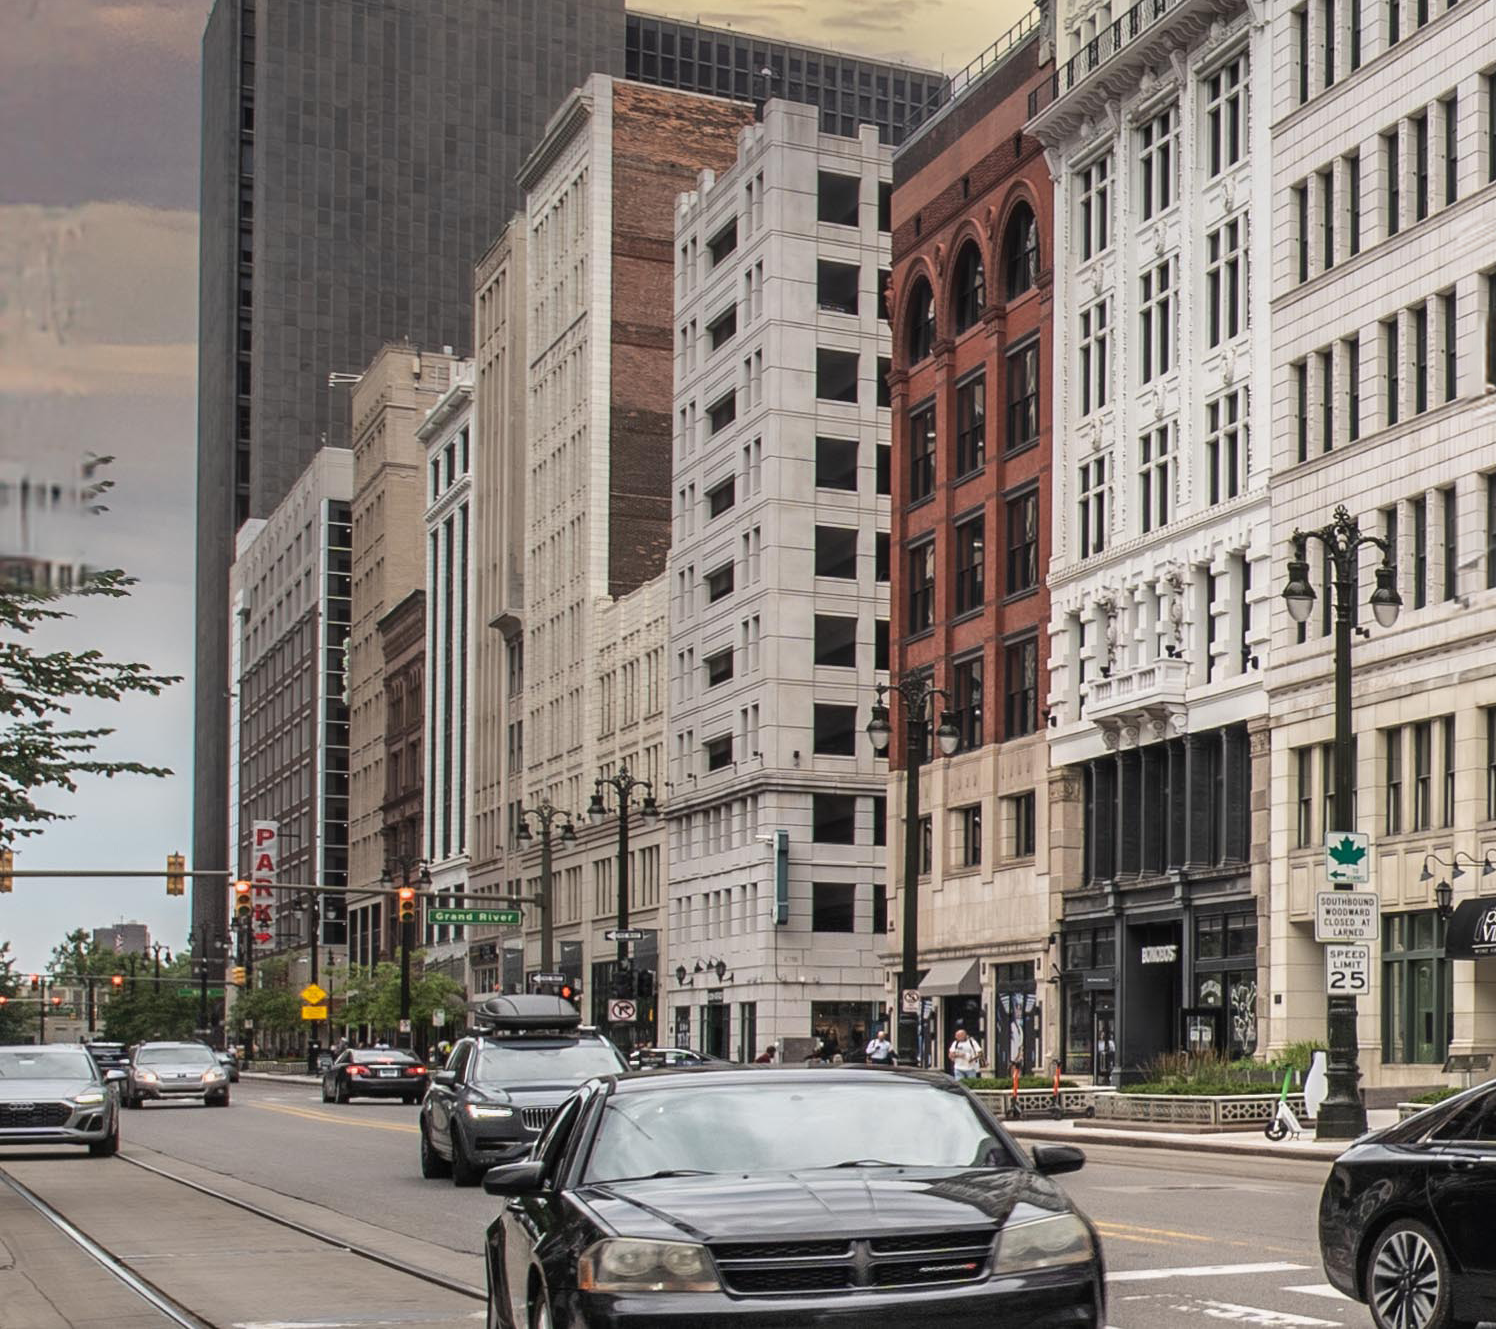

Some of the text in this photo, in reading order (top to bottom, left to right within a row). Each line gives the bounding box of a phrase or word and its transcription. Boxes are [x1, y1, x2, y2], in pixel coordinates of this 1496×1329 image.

[255, 828, 275, 922] PARK
[1321, 897, 1375, 907] SOUTHBOUND
[1325, 908, 1371, 916] WOODWARD
[435, 912, 513, 922] Grand River
[1324, 918, 1371, 926] CLOSED AT
[1333, 928, 1365, 937] LARNED
[1330, 950, 1366, 959] SPEED
[1333, 961, 1362, 969] LIMIT
[1330, 971, 1366, 989] 25
